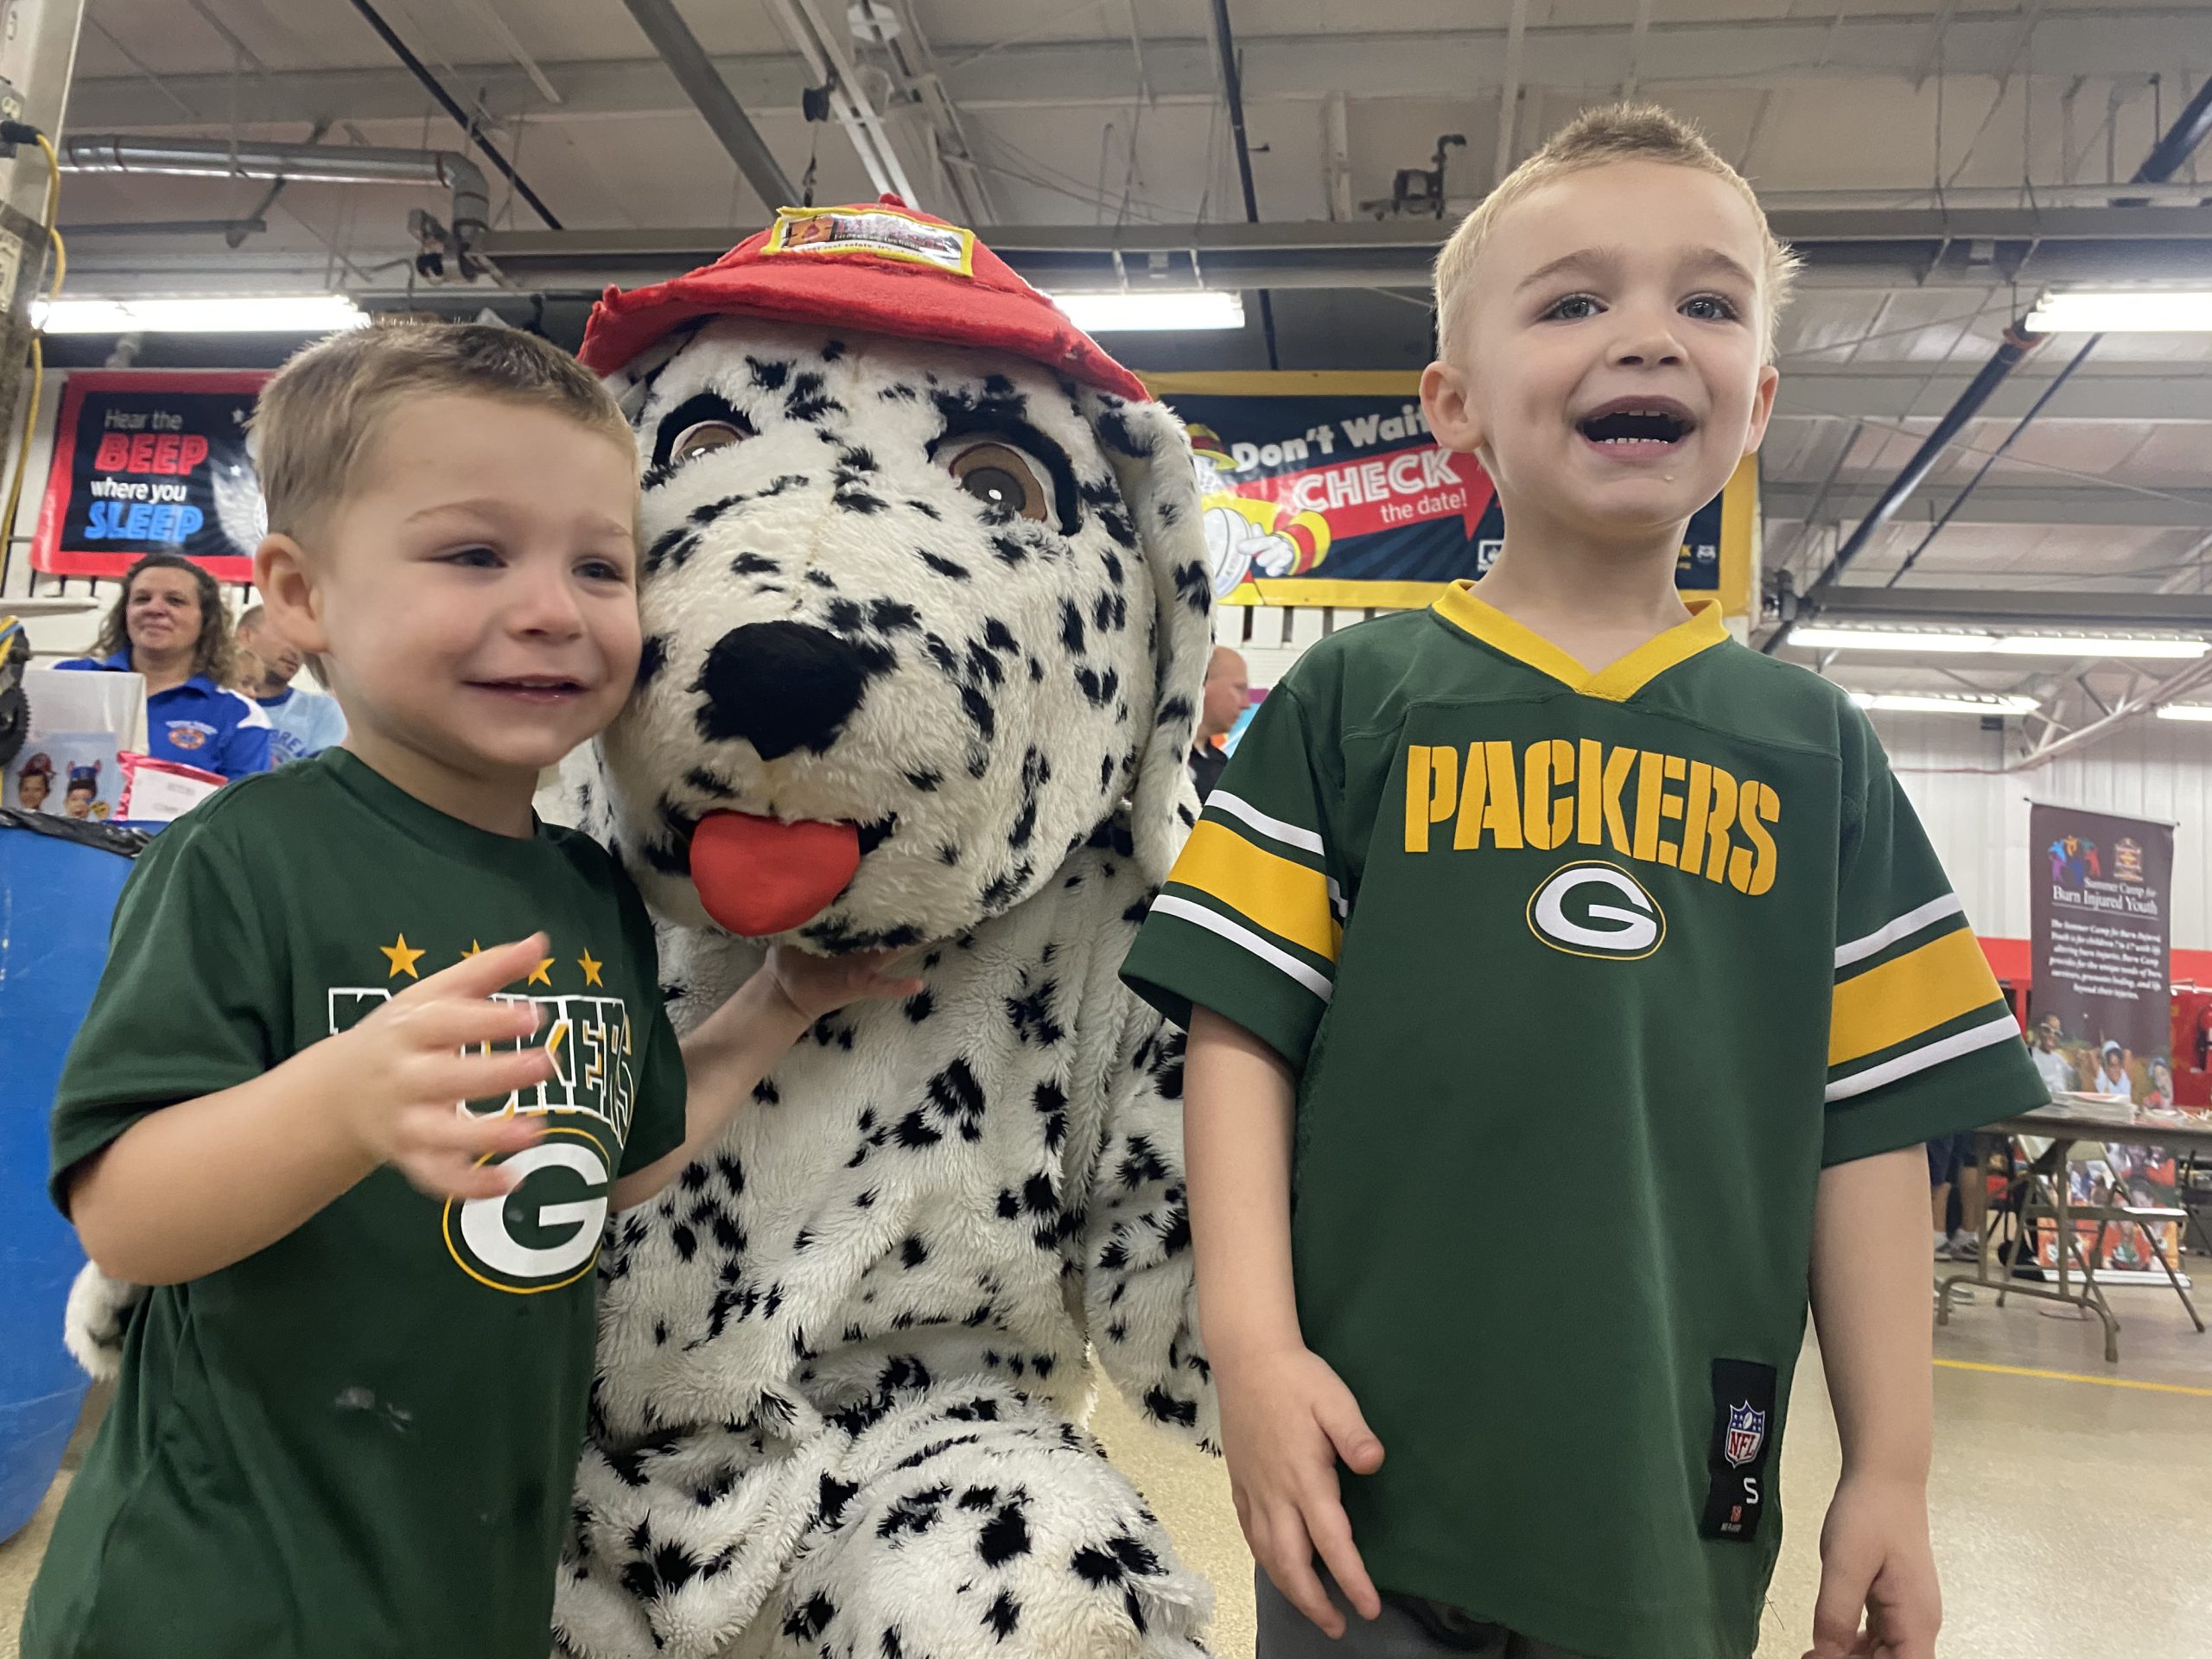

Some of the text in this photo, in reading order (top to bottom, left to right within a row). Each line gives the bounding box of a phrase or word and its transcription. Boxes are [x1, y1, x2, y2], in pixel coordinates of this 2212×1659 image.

[104, 409, 183, 430] Hear the
[94, 432, 208, 475] BEEP
[1231, 424, 1335, 472] Don't
[90, 476, 188, 505] where you
[1293, 448, 1463, 513] CHECK
[84, 500, 204, 543] SLEEP
[1380, 487, 1468, 524] the date!
[1404, 738, 1781, 896] PACKERS
[1535, 868, 1658, 951] G
[2053, 884, 2158, 916] Burn Injured Youth
[2119, 882, 2145, 899] Camp
[460, 1141, 608, 1278] G
[1727, 1430, 1757, 1460] NFL
[1743, 1477, 1759, 1504] S
